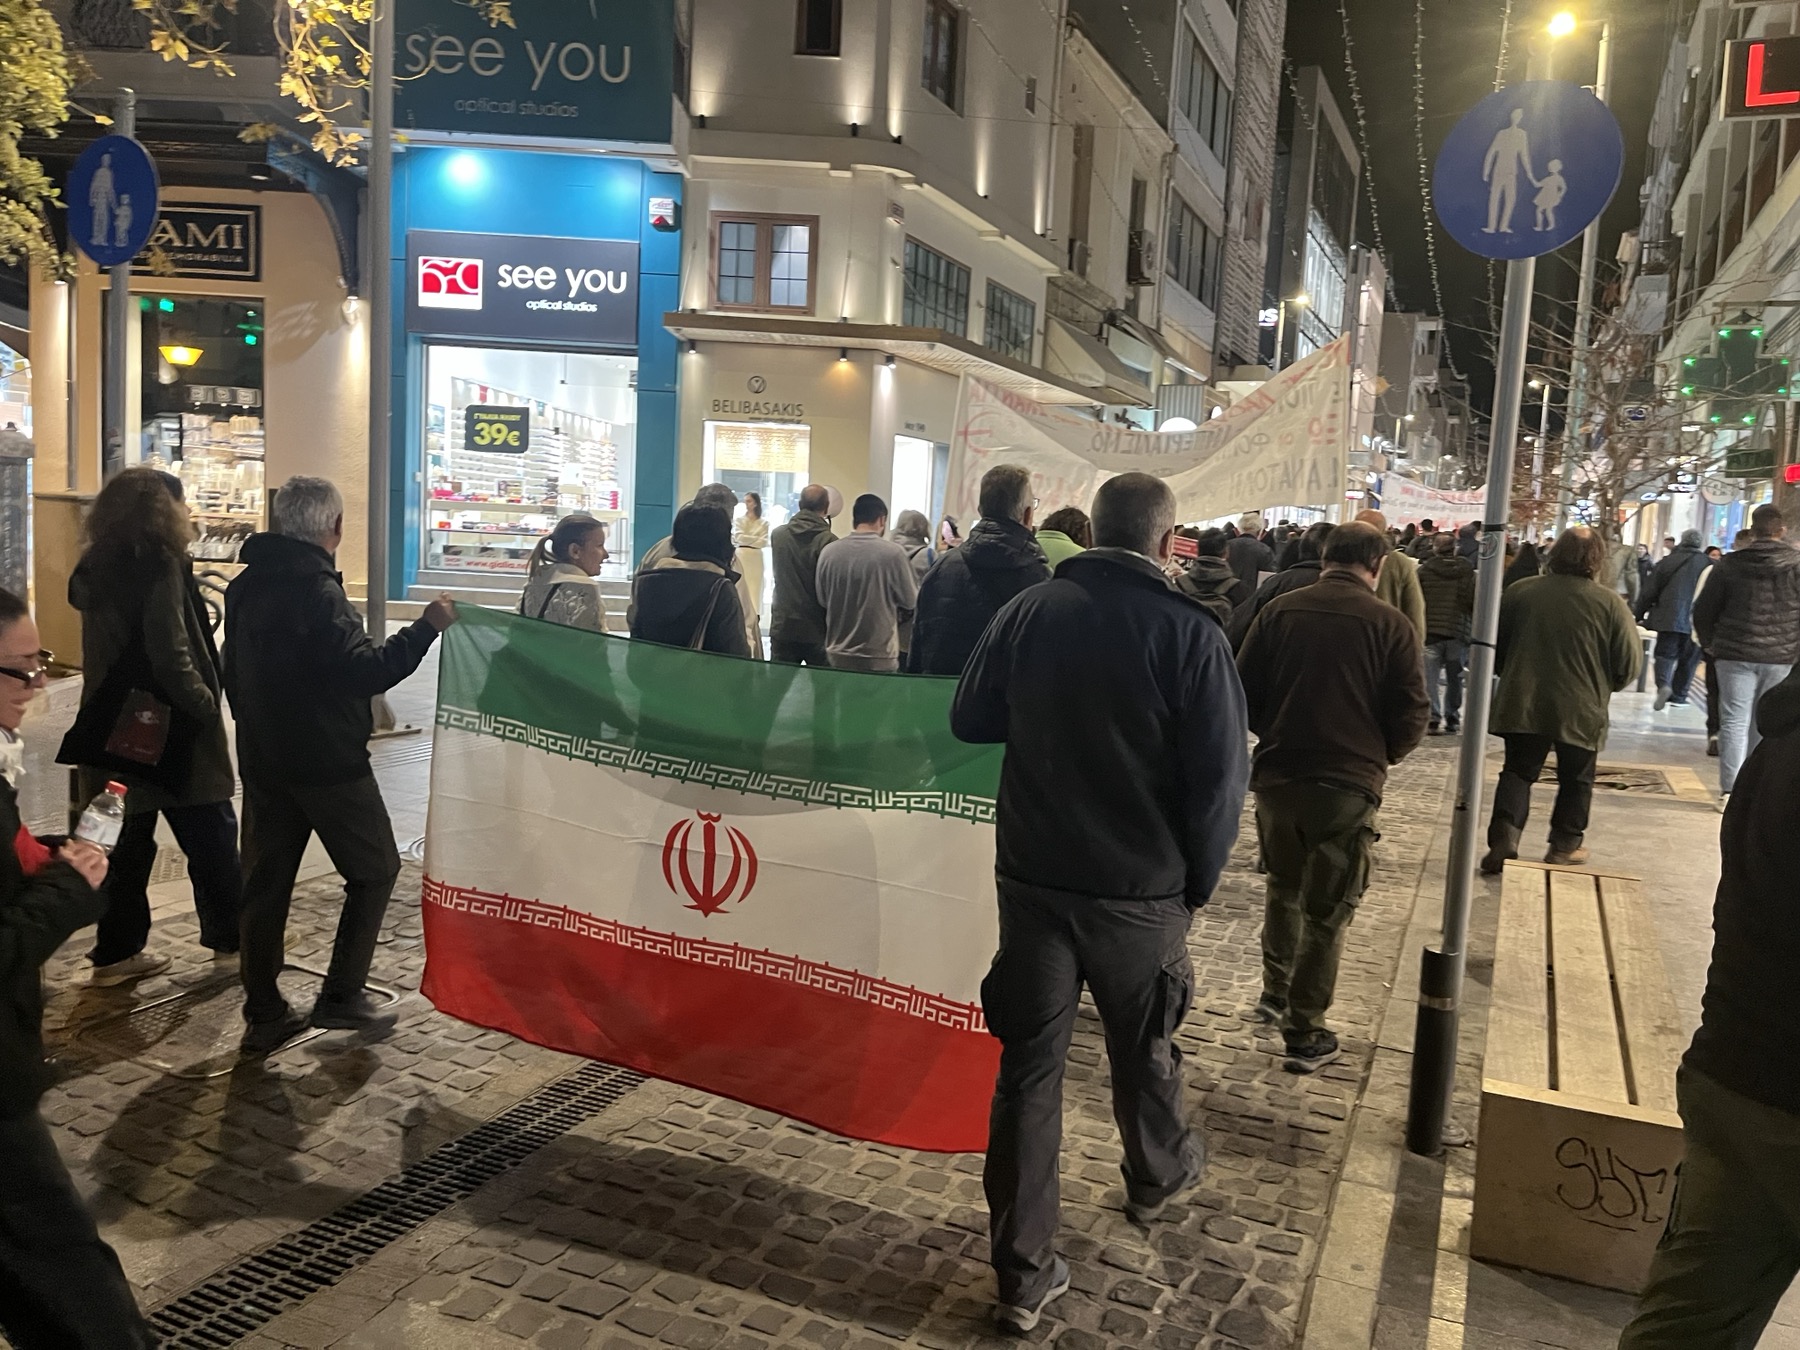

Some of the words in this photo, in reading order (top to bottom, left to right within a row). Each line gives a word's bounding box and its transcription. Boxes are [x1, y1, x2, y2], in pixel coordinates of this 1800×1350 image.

[404, 34, 506, 76] see
[523, 40, 631, 91] you
[454, 98, 516, 114] optical
[518, 101, 579, 118] studios
[497, 263, 557, 290] see
[564, 268, 628, 298] you
[525, 300, 563, 311] optical
[562, 301, 598, 313] studios
[712, 399, 804, 417] BELIBASAKIS
[473, 422, 520, 446] 39€
